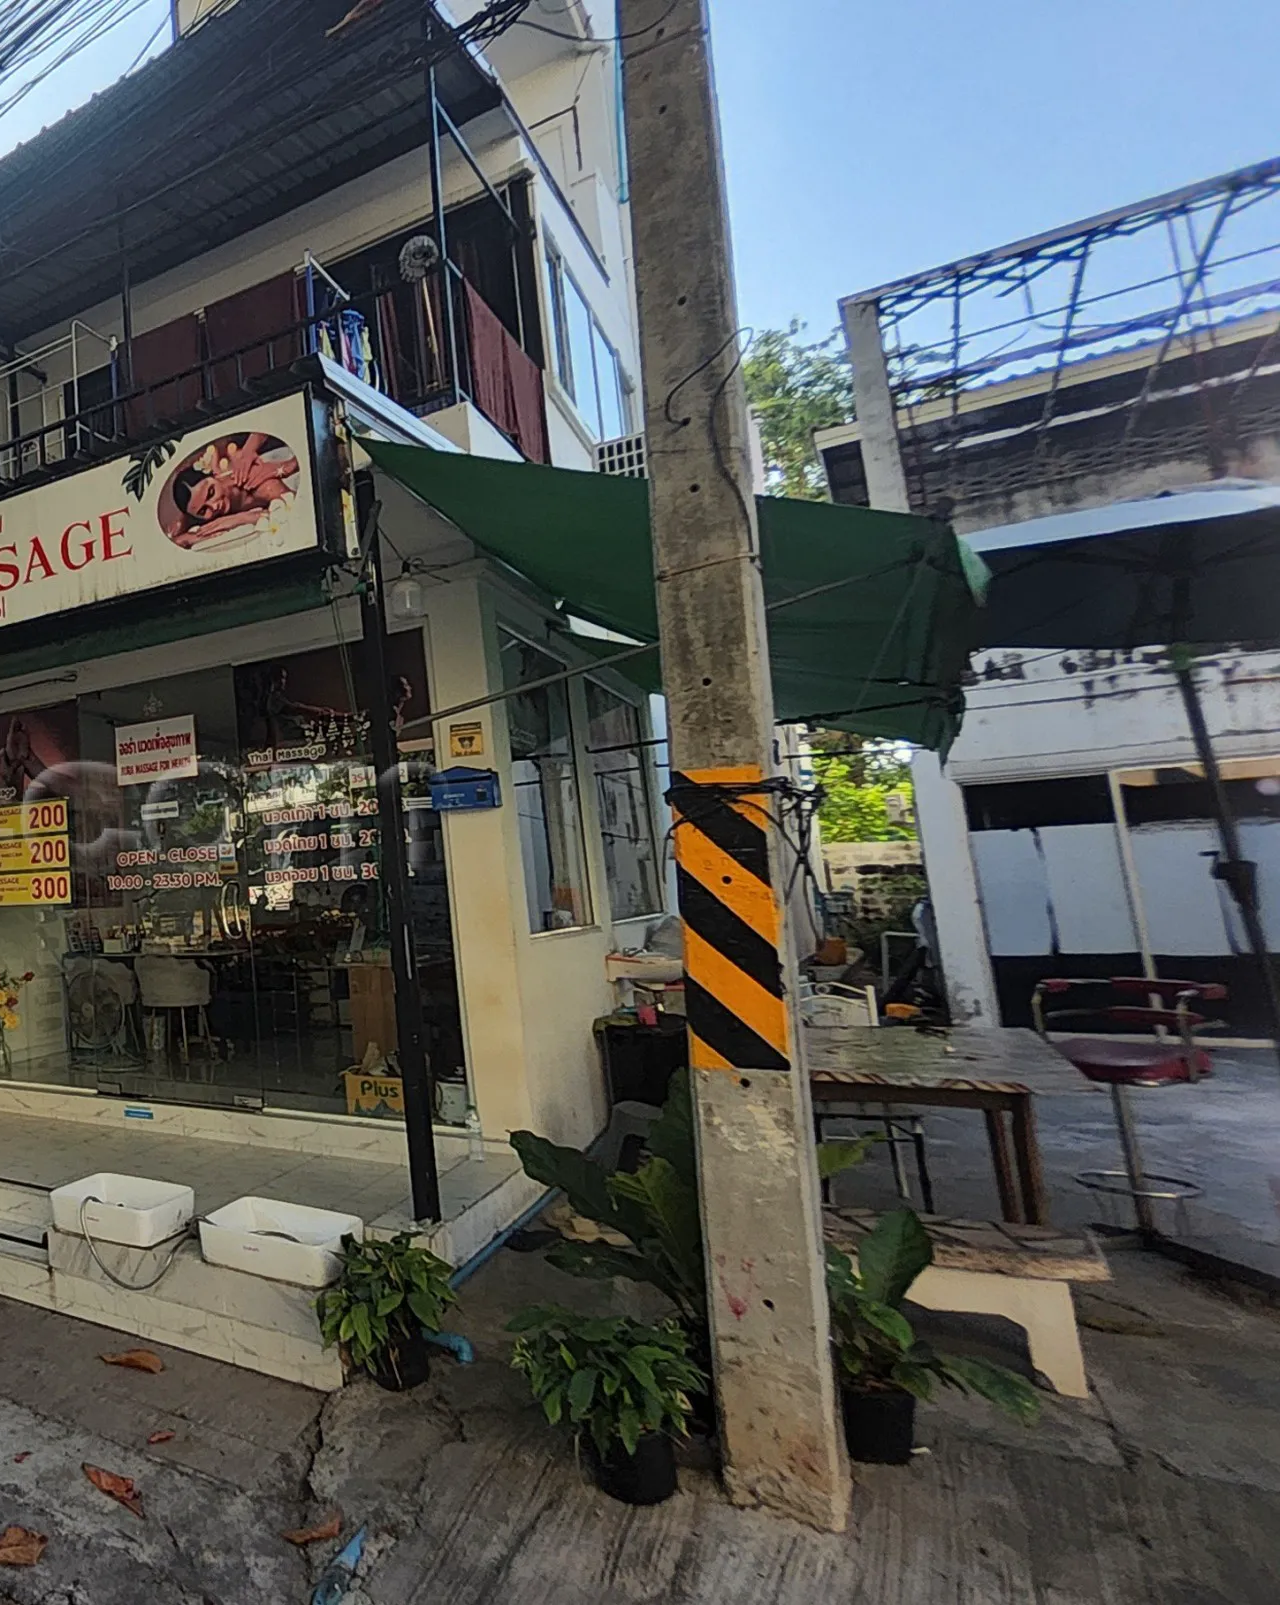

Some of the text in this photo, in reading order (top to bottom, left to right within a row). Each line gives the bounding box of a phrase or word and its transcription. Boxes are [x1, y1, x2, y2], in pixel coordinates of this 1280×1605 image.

[247, 744, 327, 764] Thai Massage
[135, 761, 158, 774] MASSAGE
[159, 759, 170, 771] FOR
[29, 804, 65, 829] 200
[319, 804, 327, 820] 1
[30, 839, 66, 864] 200
[263, 833, 318, 855] นวดไทย
[319, 834, 327, 850] 1
[116, 851, 158, 867] OPEN
[167, 847, 218, 864] CLOSE
[107, 874, 144, 890] 10.00
[152, 873, 191, 889] 23.30
[321, 864, 329, 881] 1
[31, 876, 68, 900] 300
[360, 1079, 399, 1098] Plus
